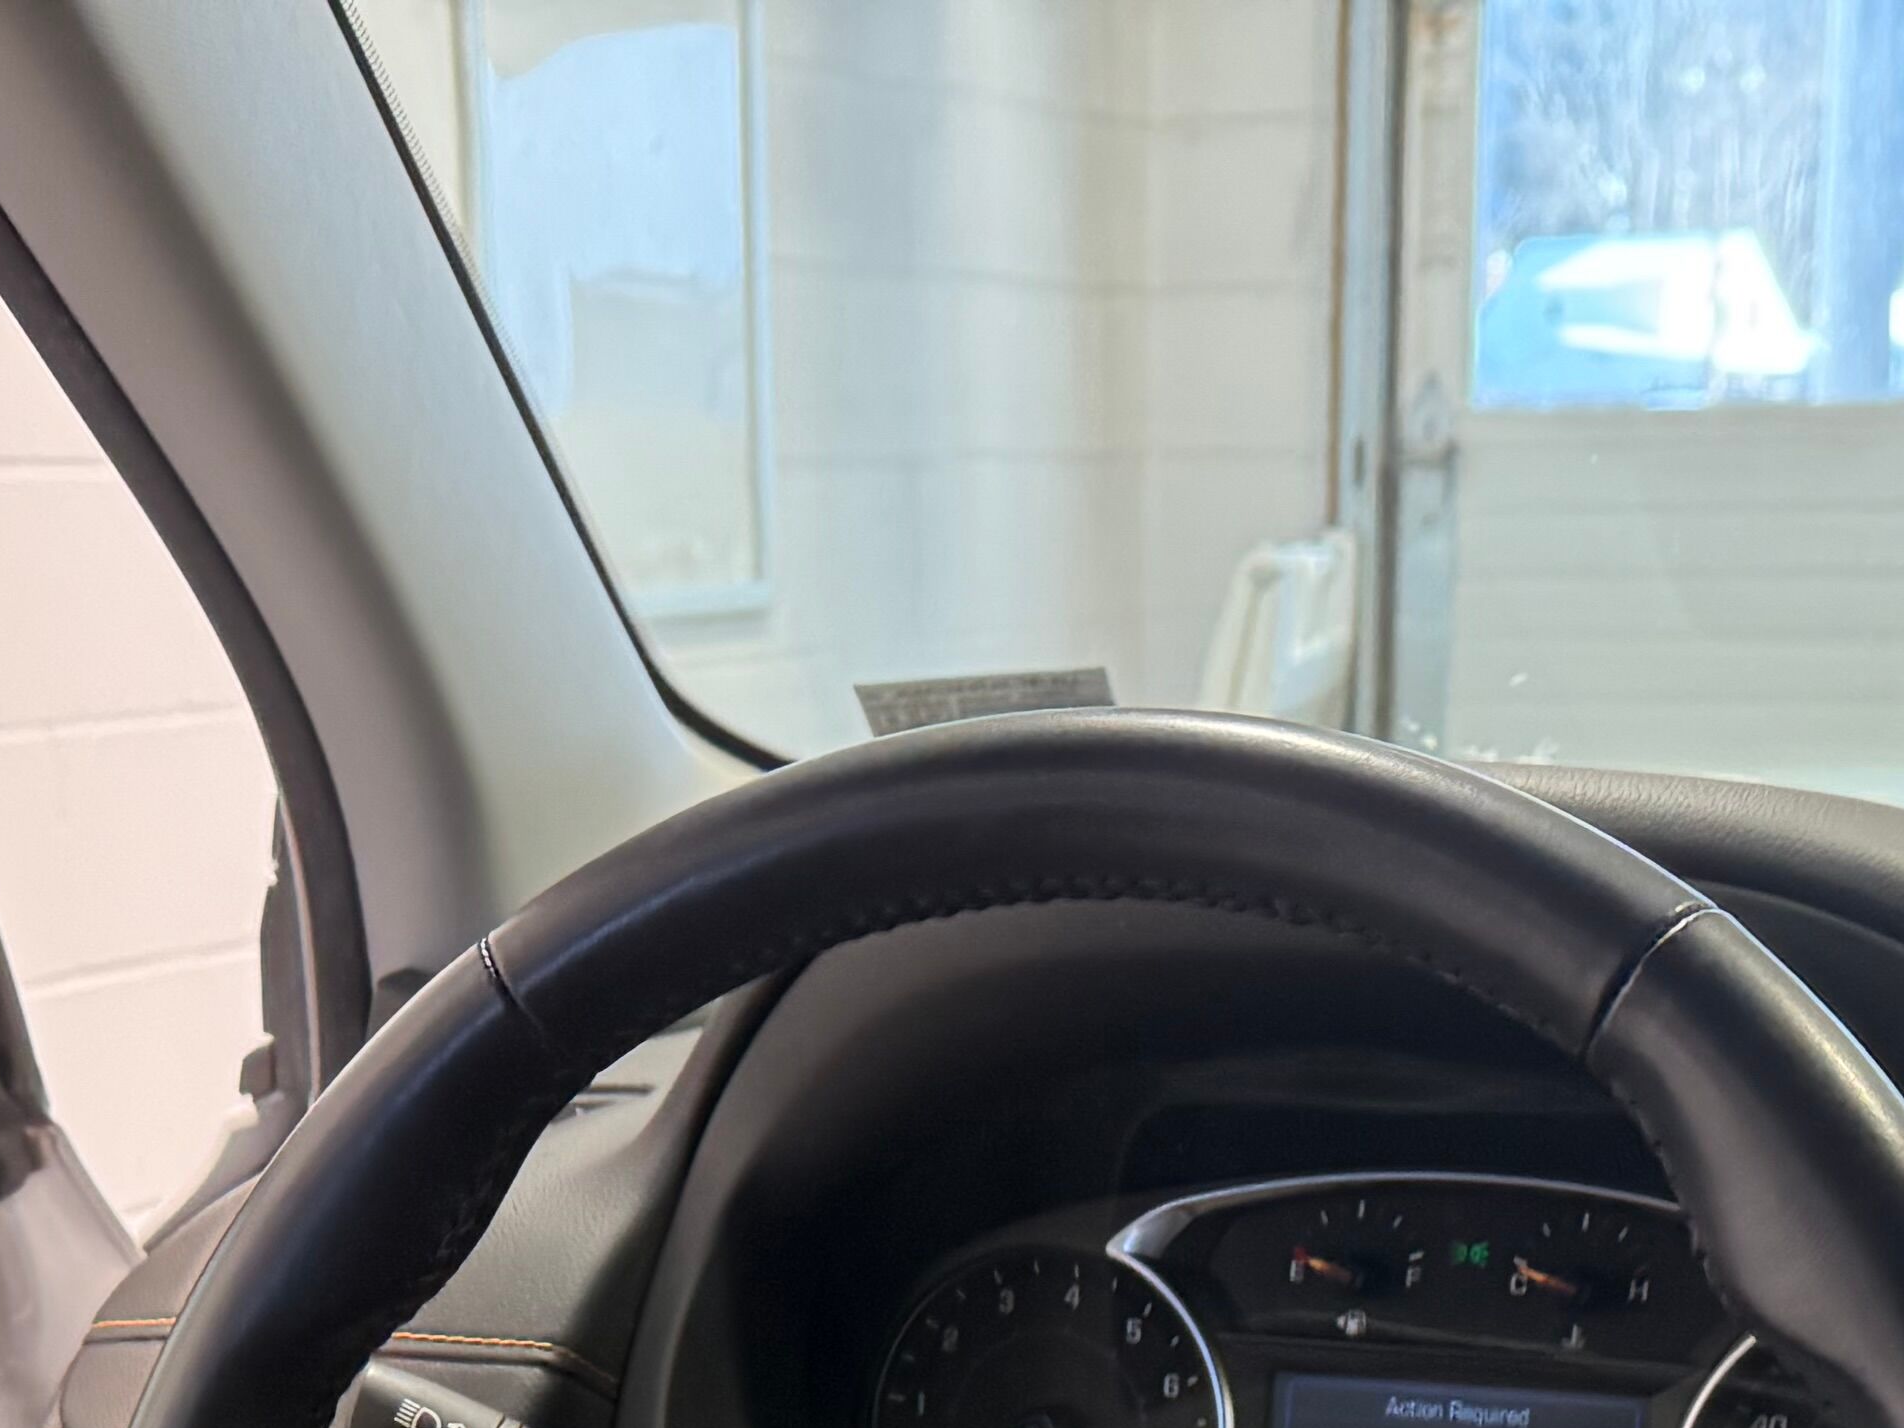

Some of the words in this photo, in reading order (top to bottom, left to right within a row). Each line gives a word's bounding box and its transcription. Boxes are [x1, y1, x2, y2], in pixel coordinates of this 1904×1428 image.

[1629, 1279, 1648, 1302] H
[1126, 1319, 1142, 1345] 5
[1163, 1373, 1180, 1399] 6
[1386, 1397, 1443, 1419] Action
[1450, 1400, 1530, 1428] Required
